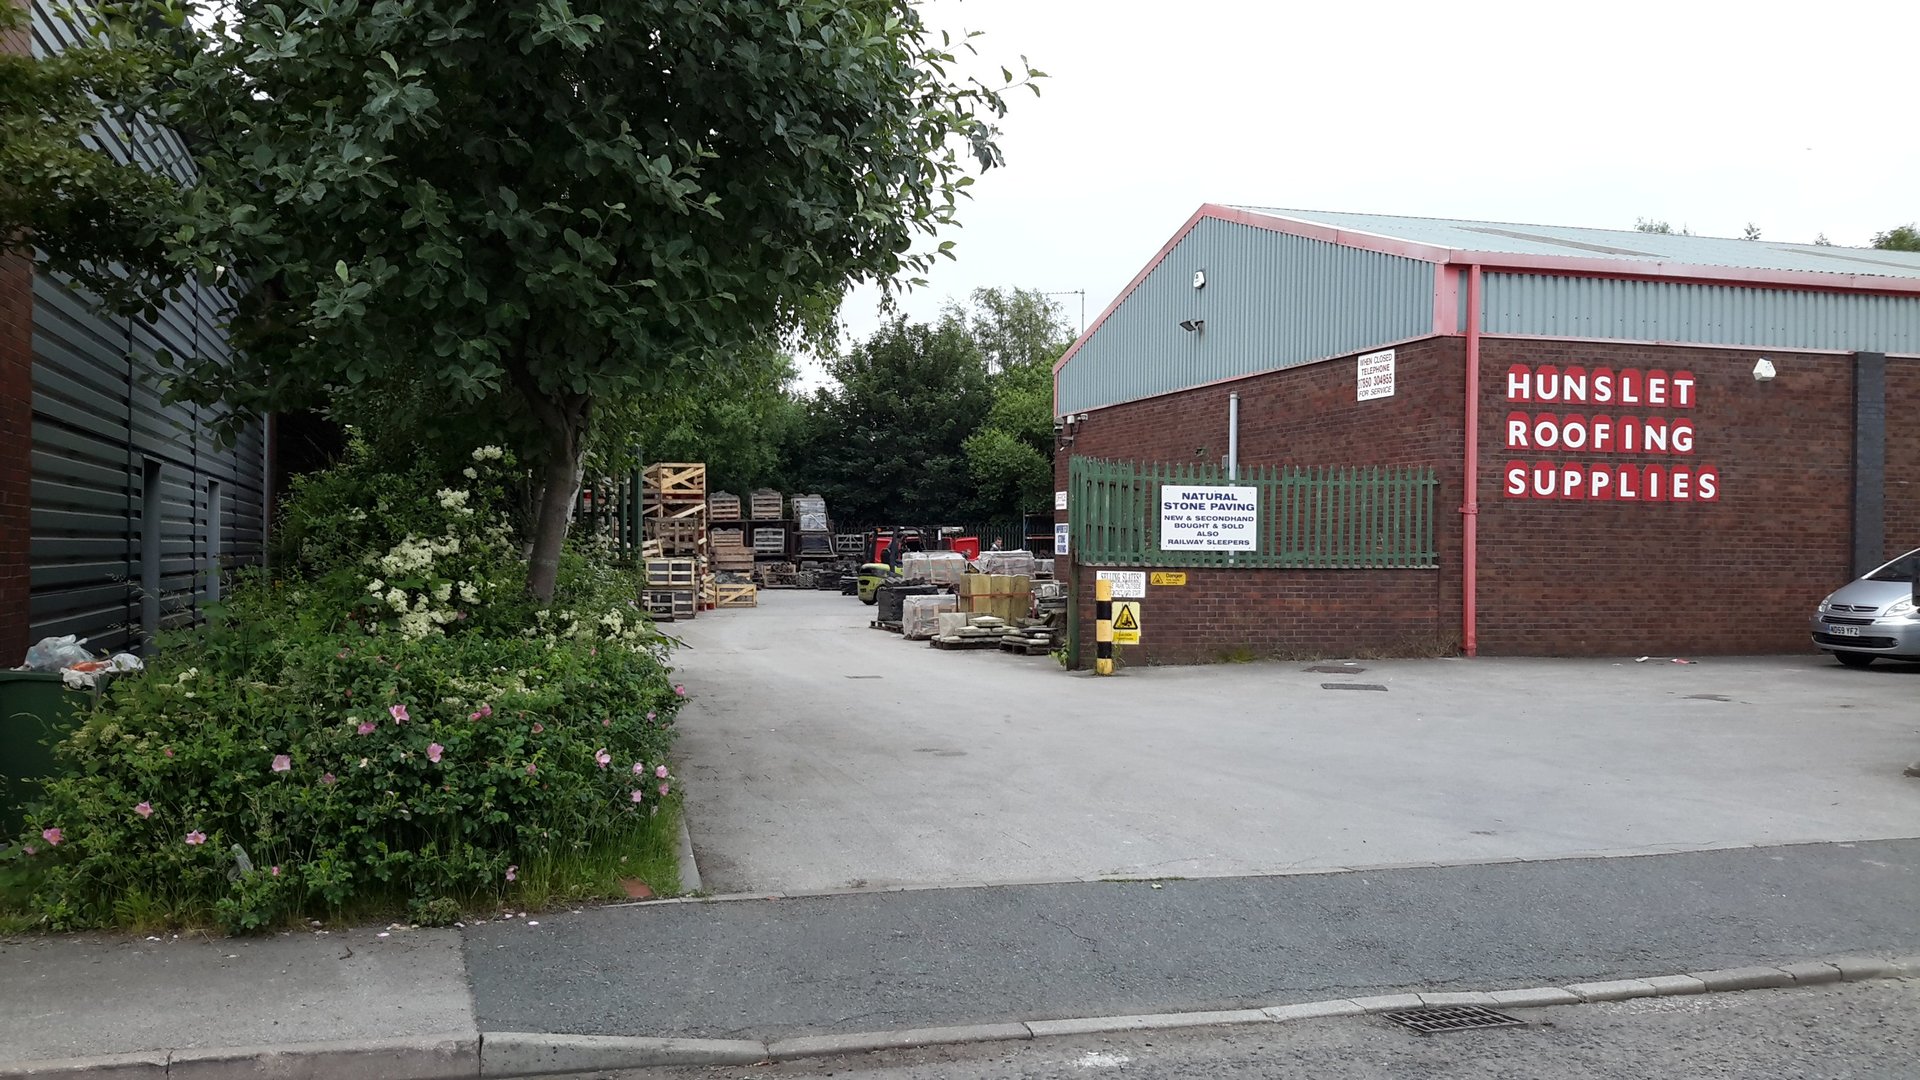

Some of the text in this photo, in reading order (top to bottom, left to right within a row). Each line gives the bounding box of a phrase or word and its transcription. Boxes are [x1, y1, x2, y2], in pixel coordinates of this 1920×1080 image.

[1360, 354, 1392, 366] WHEN CLOSED
[1362, 364, 1390, 376] TELEPHONE
[1370, 386, 1391, 396] SERVICE
[1508, 373, 1694, 405] HUNSLET
[1508, 420, 1693, 452] ROOFING
[1508, 468, 1716, 499] SUPPLIES
[1182, 493, 1238, 501] NATURAL
[1164, 502, 1255, 512] STONE PAVING
